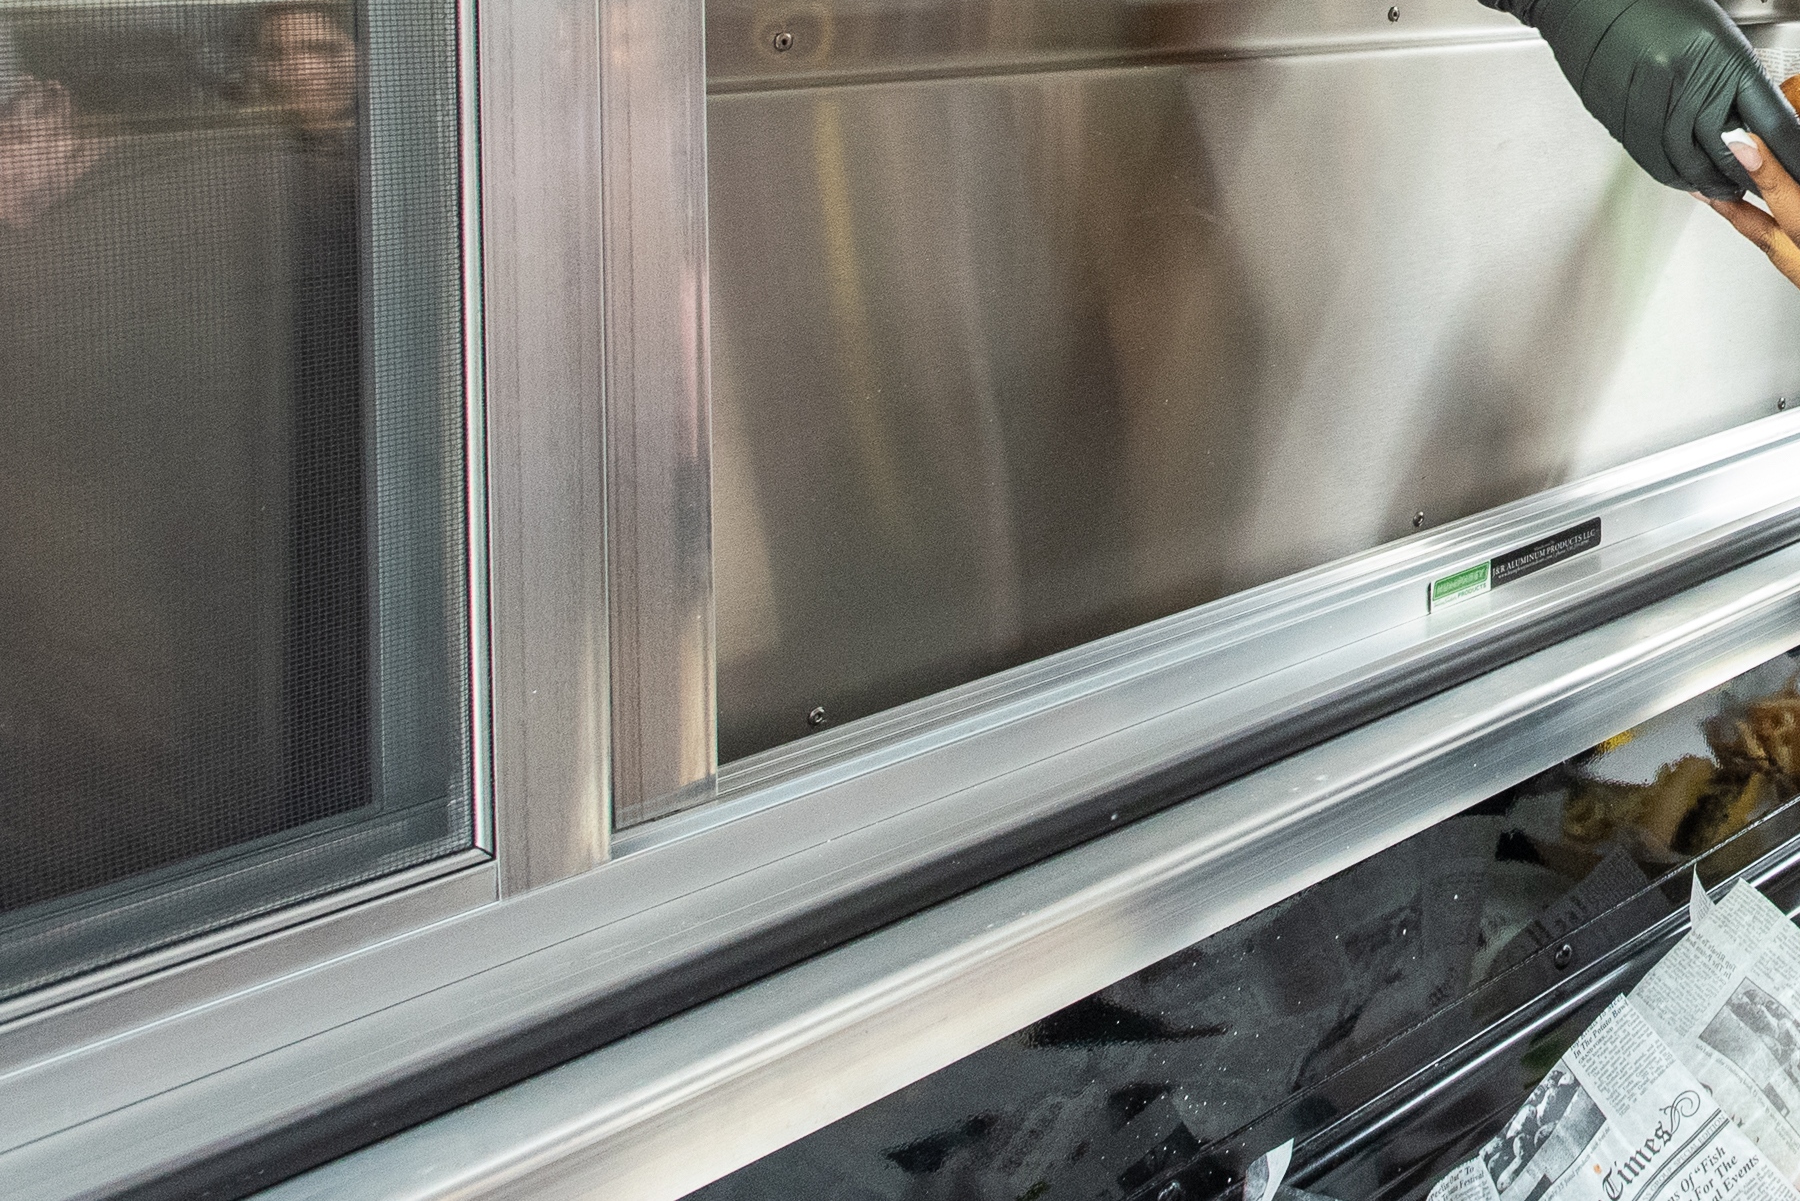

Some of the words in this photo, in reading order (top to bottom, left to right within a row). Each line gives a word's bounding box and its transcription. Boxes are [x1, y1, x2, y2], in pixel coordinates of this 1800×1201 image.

[1507, 549, 1546, 570] ALUMINUM
[1546, 536, 1583, 556] PRODUCTS
[1583, 529, 1596, 541] LLC
[1458, 583, 1487, 598] PRODUCTS
[1572, 1049, 1582, 1059] In
[1580, 1038, 1593, 1051] The
[1591, 1017, 1614, 1039] Potato
[1611, 1000, 1629, 1018] Bowl
[1464, 1165, 1476, 1174] To
[1602, 1120, 1673, 1201] Times
[1650, 1165, 1674, 1192] GROUP
[1673, 1139, 1700, 1167] SPECIAL
[1697, 1114, 1726, 1143] EDITION
[1680, 1172, 1697, 1194] Of
[1693, 1145, 1727, 1177] “Fish
[1722, 1154, 1760, 1191] Events
[1458, 1170, 1485, 1189] Festival
[1695, 1177, 1716, 1201] For
[1713, 1154, 1739, 1180] The
